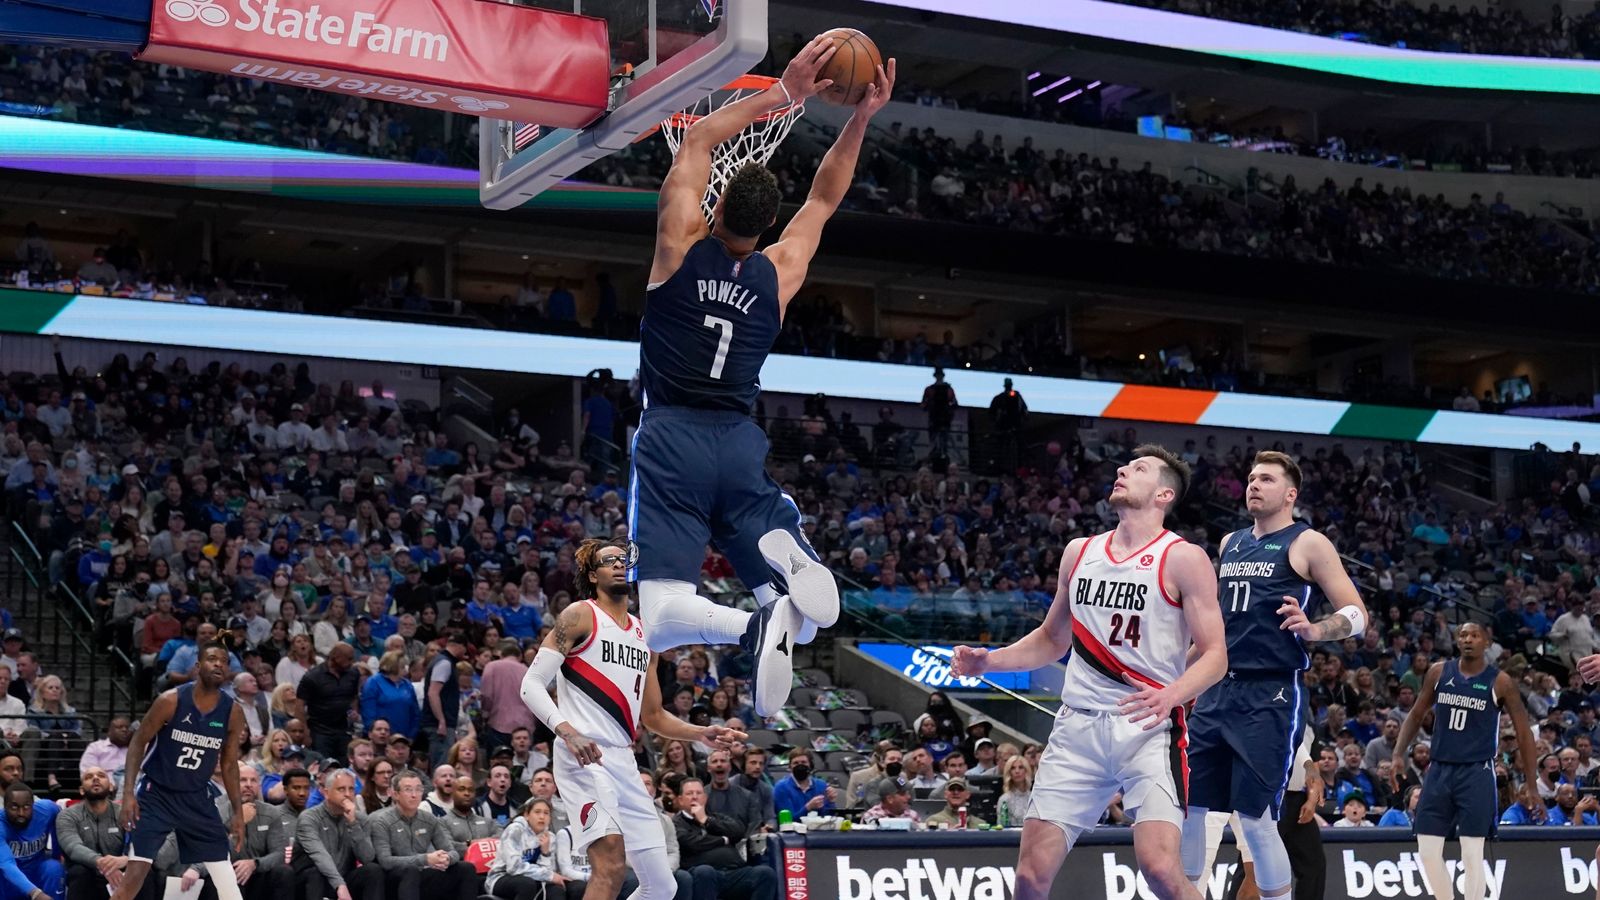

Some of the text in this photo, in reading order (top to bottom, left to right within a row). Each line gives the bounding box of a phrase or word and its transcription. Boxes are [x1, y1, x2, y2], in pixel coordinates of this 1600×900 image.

[697, 279, 758, 315] POWELL
[703, 314, 734, 380] 7
[1219, 561, 1275, 579] MAVERICKS
[1075, 577, 1148, 612] BLAZERS
[1228, 580, 1251, 612] 77
[1108, 613, 1141, 648] 24
[601, 639, 648, 673] BLAZERS
[633, 673, 642, 701] 4
[1437, 692, 1487, 712] MAVERICKS
[1448, 707, 1468, 731] 10
[171, 728, 223, 750] MAVERICKS
[176, 746, 205, 770] 25
[786, 850, 806, 859] BIO
[788, 877, 807, 887] BIO
